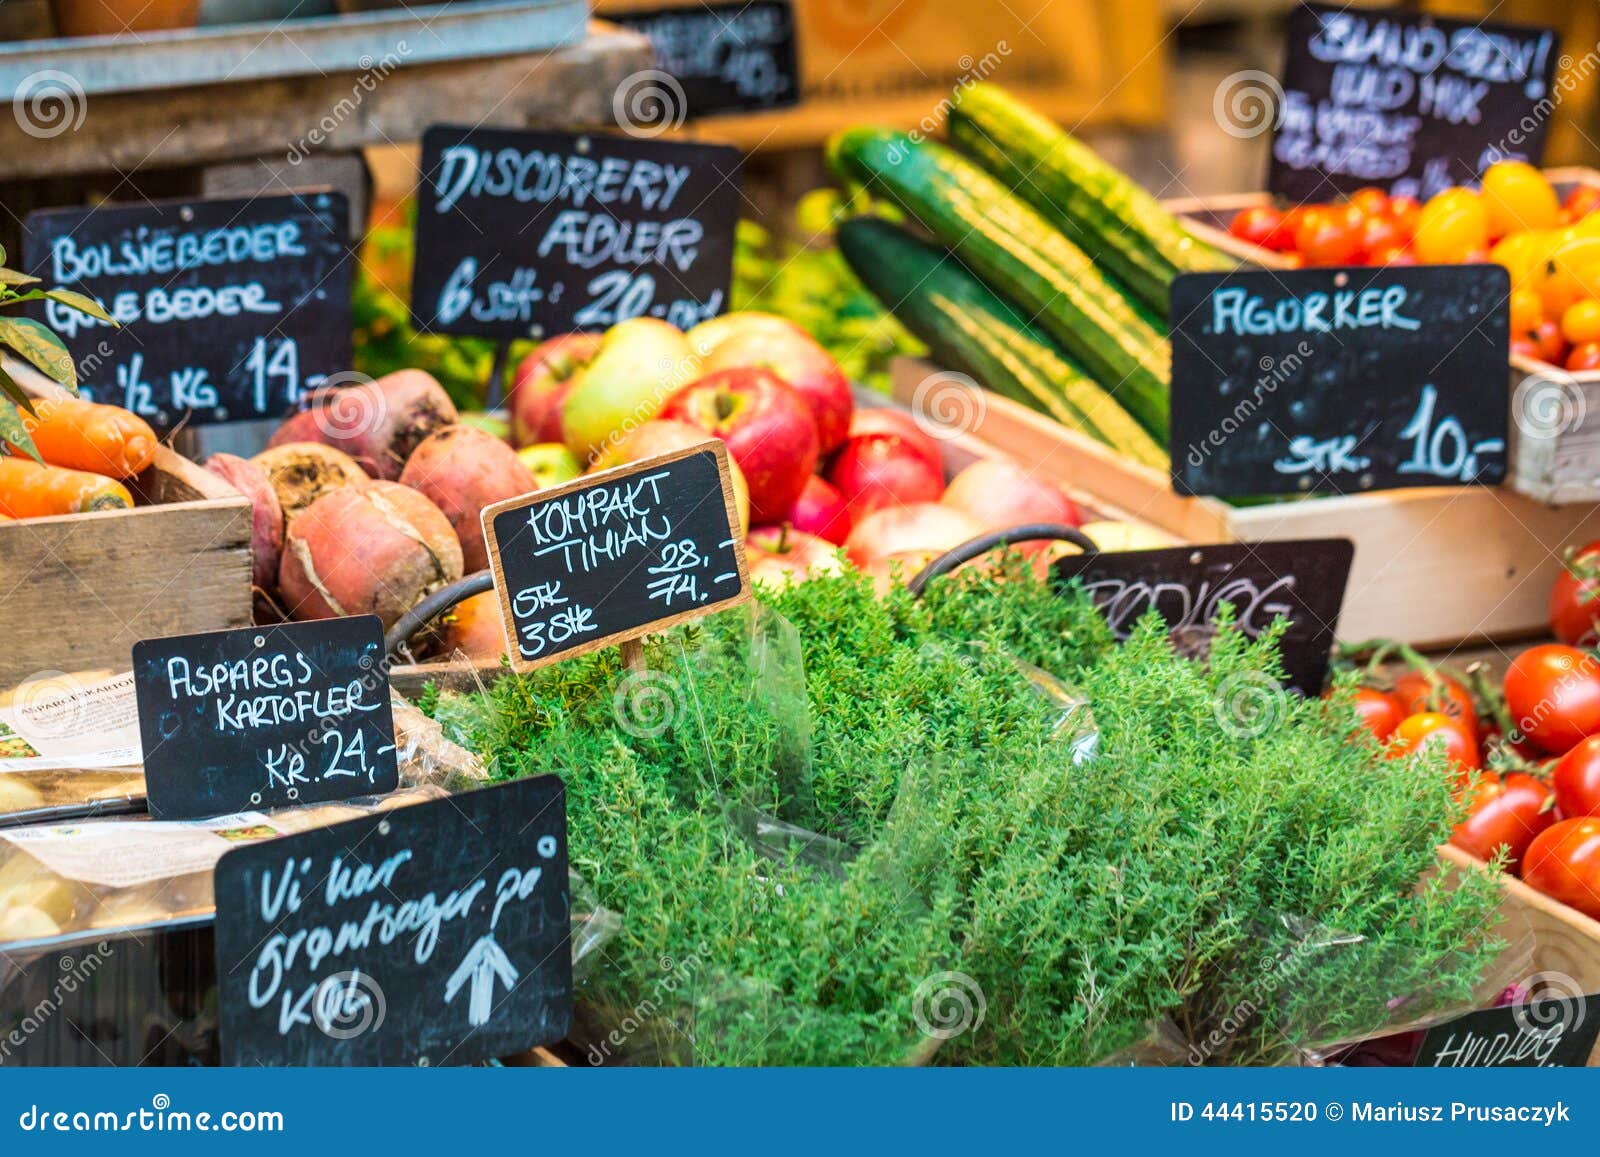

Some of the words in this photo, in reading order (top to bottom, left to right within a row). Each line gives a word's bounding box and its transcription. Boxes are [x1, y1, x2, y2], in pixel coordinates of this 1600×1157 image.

[146, 282, 282, 323] BEDER
[436, 255, 479, 324] 6
[1212, 285, 1420, 336] AGURKER
[527, 471, 671, 545] KOMPAKT
[533, 515, 672, 573] TIMIAN
[518, 622, 546, 656] 3
[167, 652, 313, 700] ASPARGS
[216, 679, 382, 731] KARTOFLER
[261, 857, 312, 923] Vi
[325, 849, 412, 906] har
